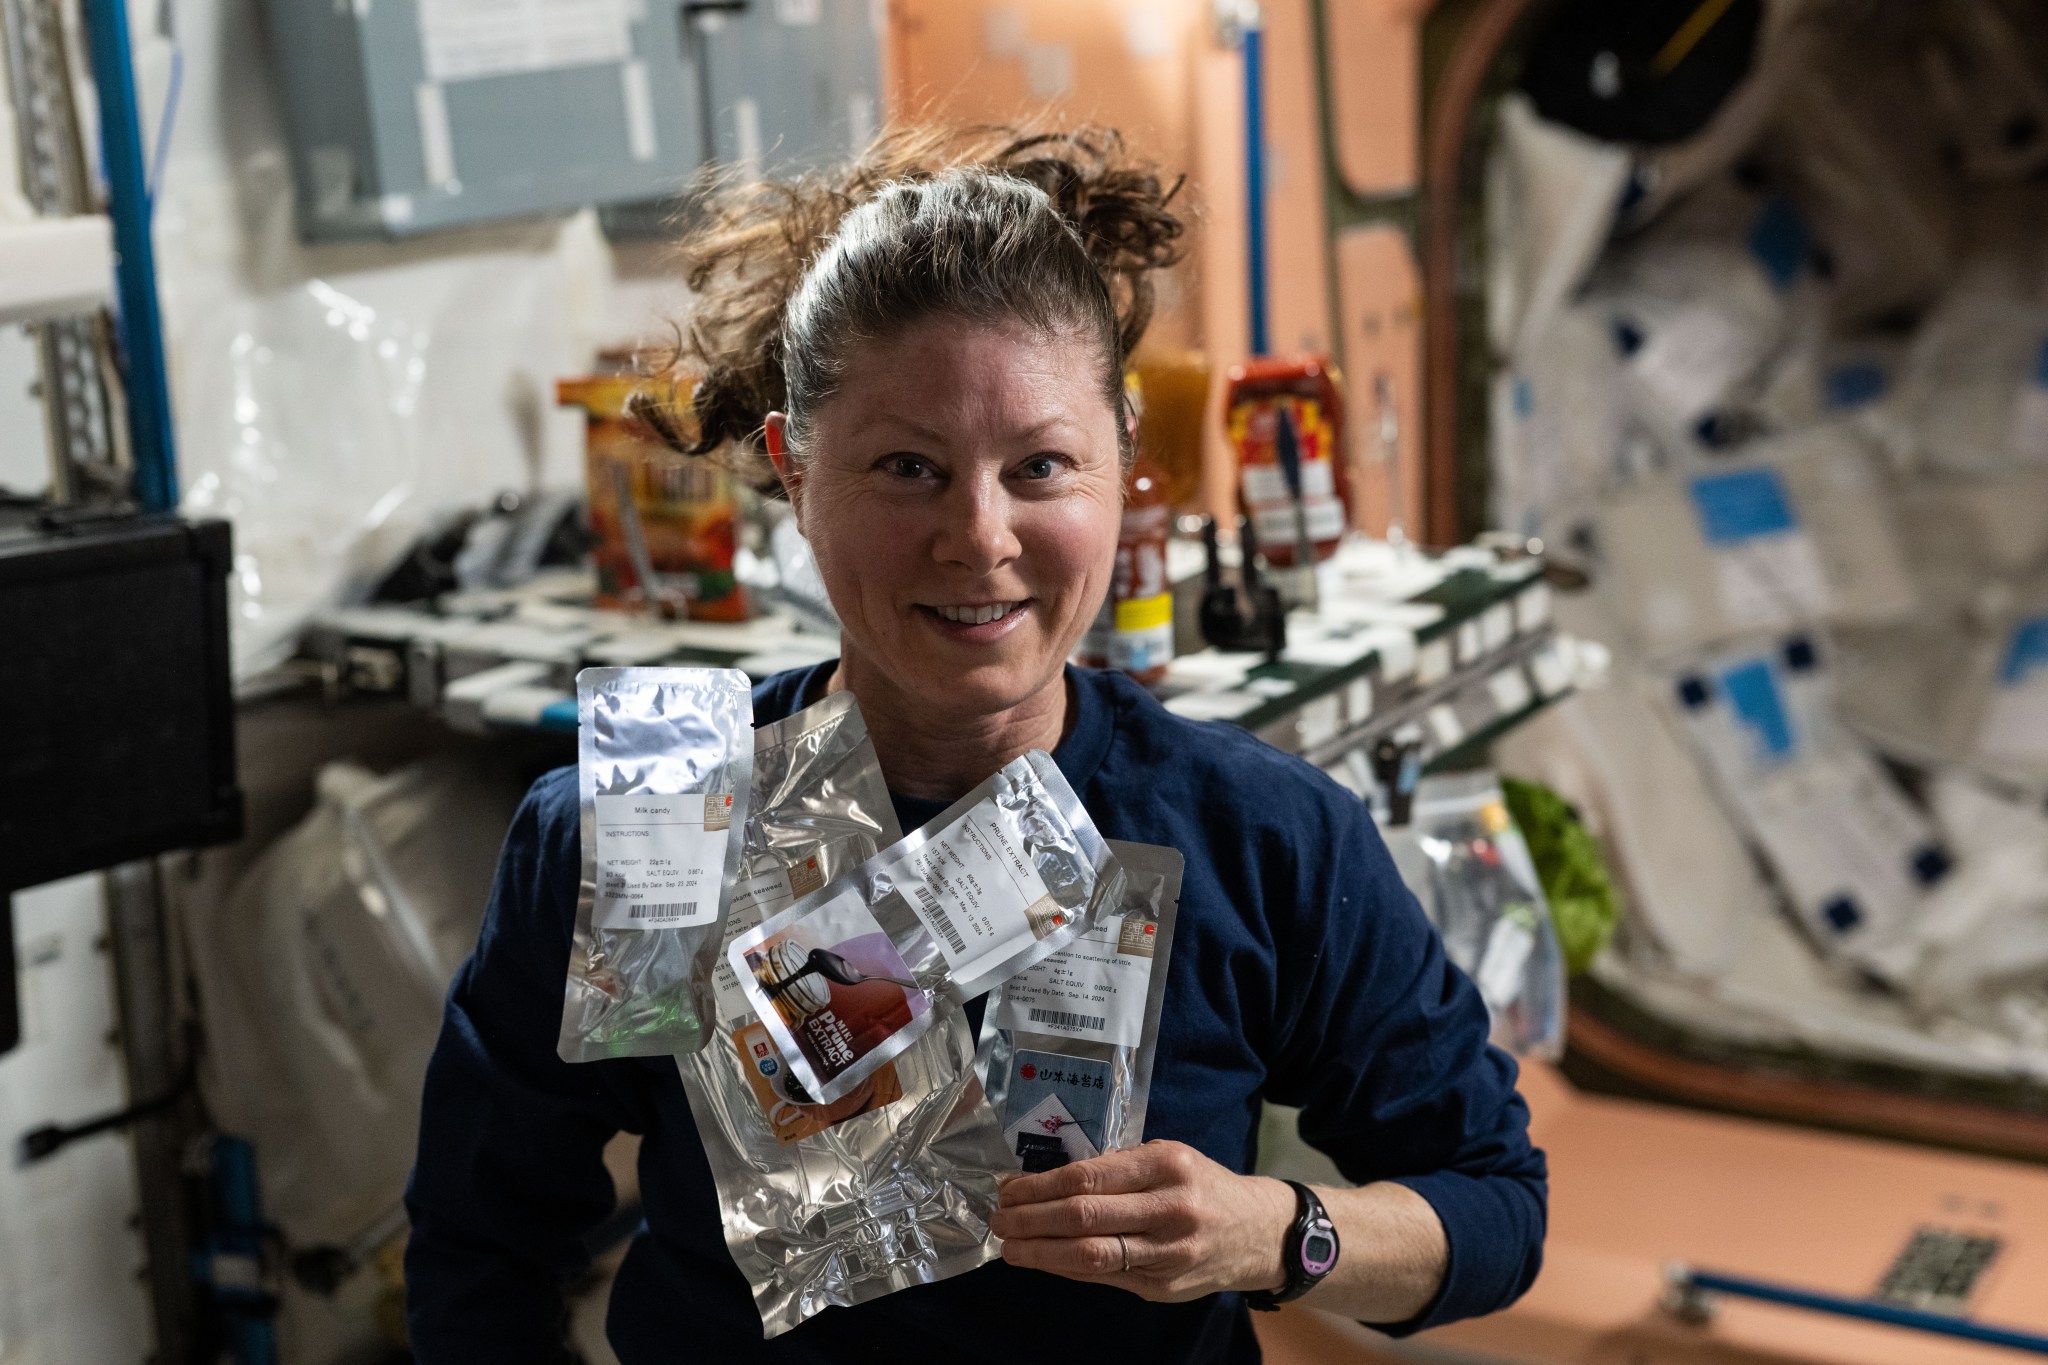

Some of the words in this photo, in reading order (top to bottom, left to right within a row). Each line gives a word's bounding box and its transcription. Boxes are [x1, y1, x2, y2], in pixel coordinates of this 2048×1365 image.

[940, 841, 950, 852] NET
[990, 822, 1008, 846] PRUNE
[1006, 846, 1029, 878] EXTRACT
[754, 882, 782, 895] seaweed
[956, 878, 968, 892] SALT
[959, 900, 968, 914] May
[972, 922, 983, 936] 2024
[718, 974, 731, 982] Best
[1028, 986, 1042, 994] Used
[820, 1010, 854, 1061] Prune
[837, 1020, 854, 1042] MIKI
[808, 1020, 845, 1066] EXTRACT
[1040, 1068, 1104, 1089] 山本海苔店
